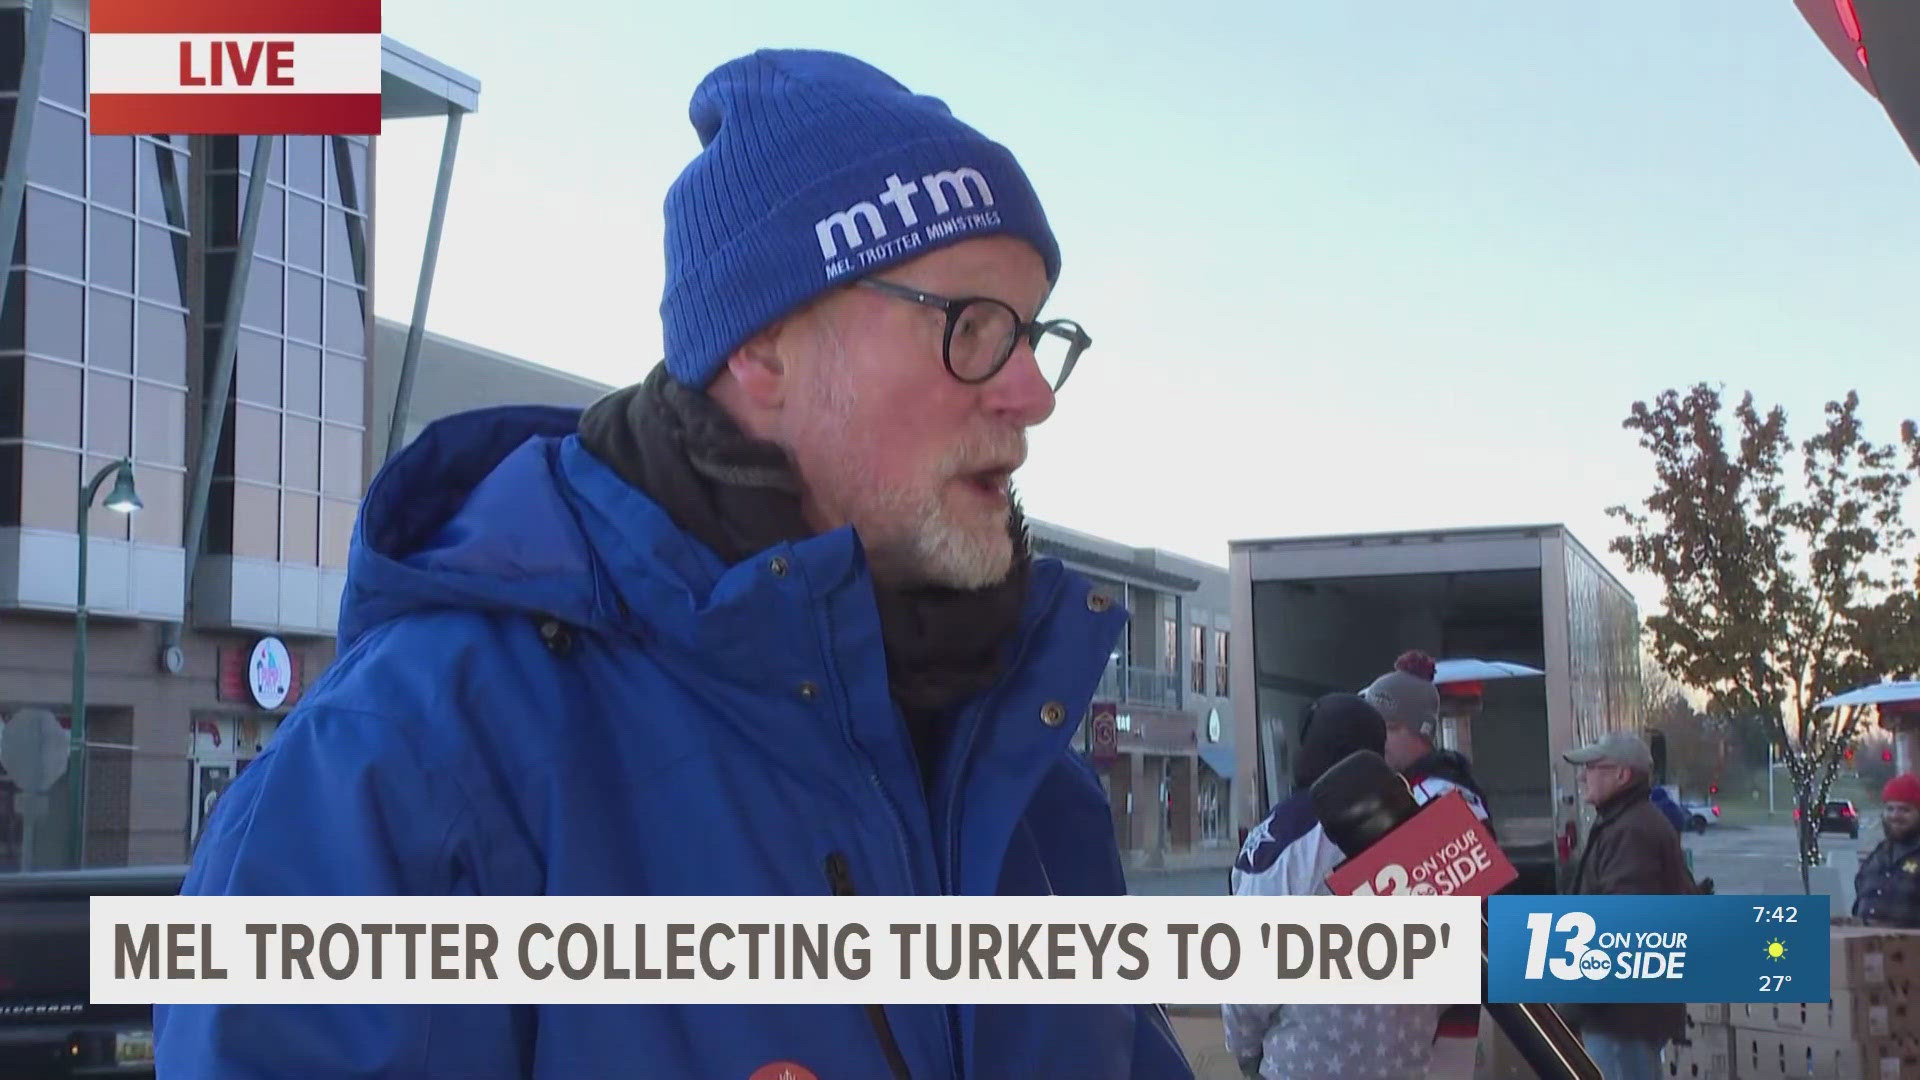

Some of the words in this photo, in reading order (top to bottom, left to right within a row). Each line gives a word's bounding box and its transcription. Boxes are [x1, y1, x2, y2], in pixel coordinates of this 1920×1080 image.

[825, 258, 854, 281] MEL
[858, 232, 922, 267] TROTTER
[925, 211, 1001, 242] MINISTRIES
[1412, 856, 1437, 882] ON
[1436, 828, 1479, 864] YOUR
[1434, 844, 1492, 895] SIDE
